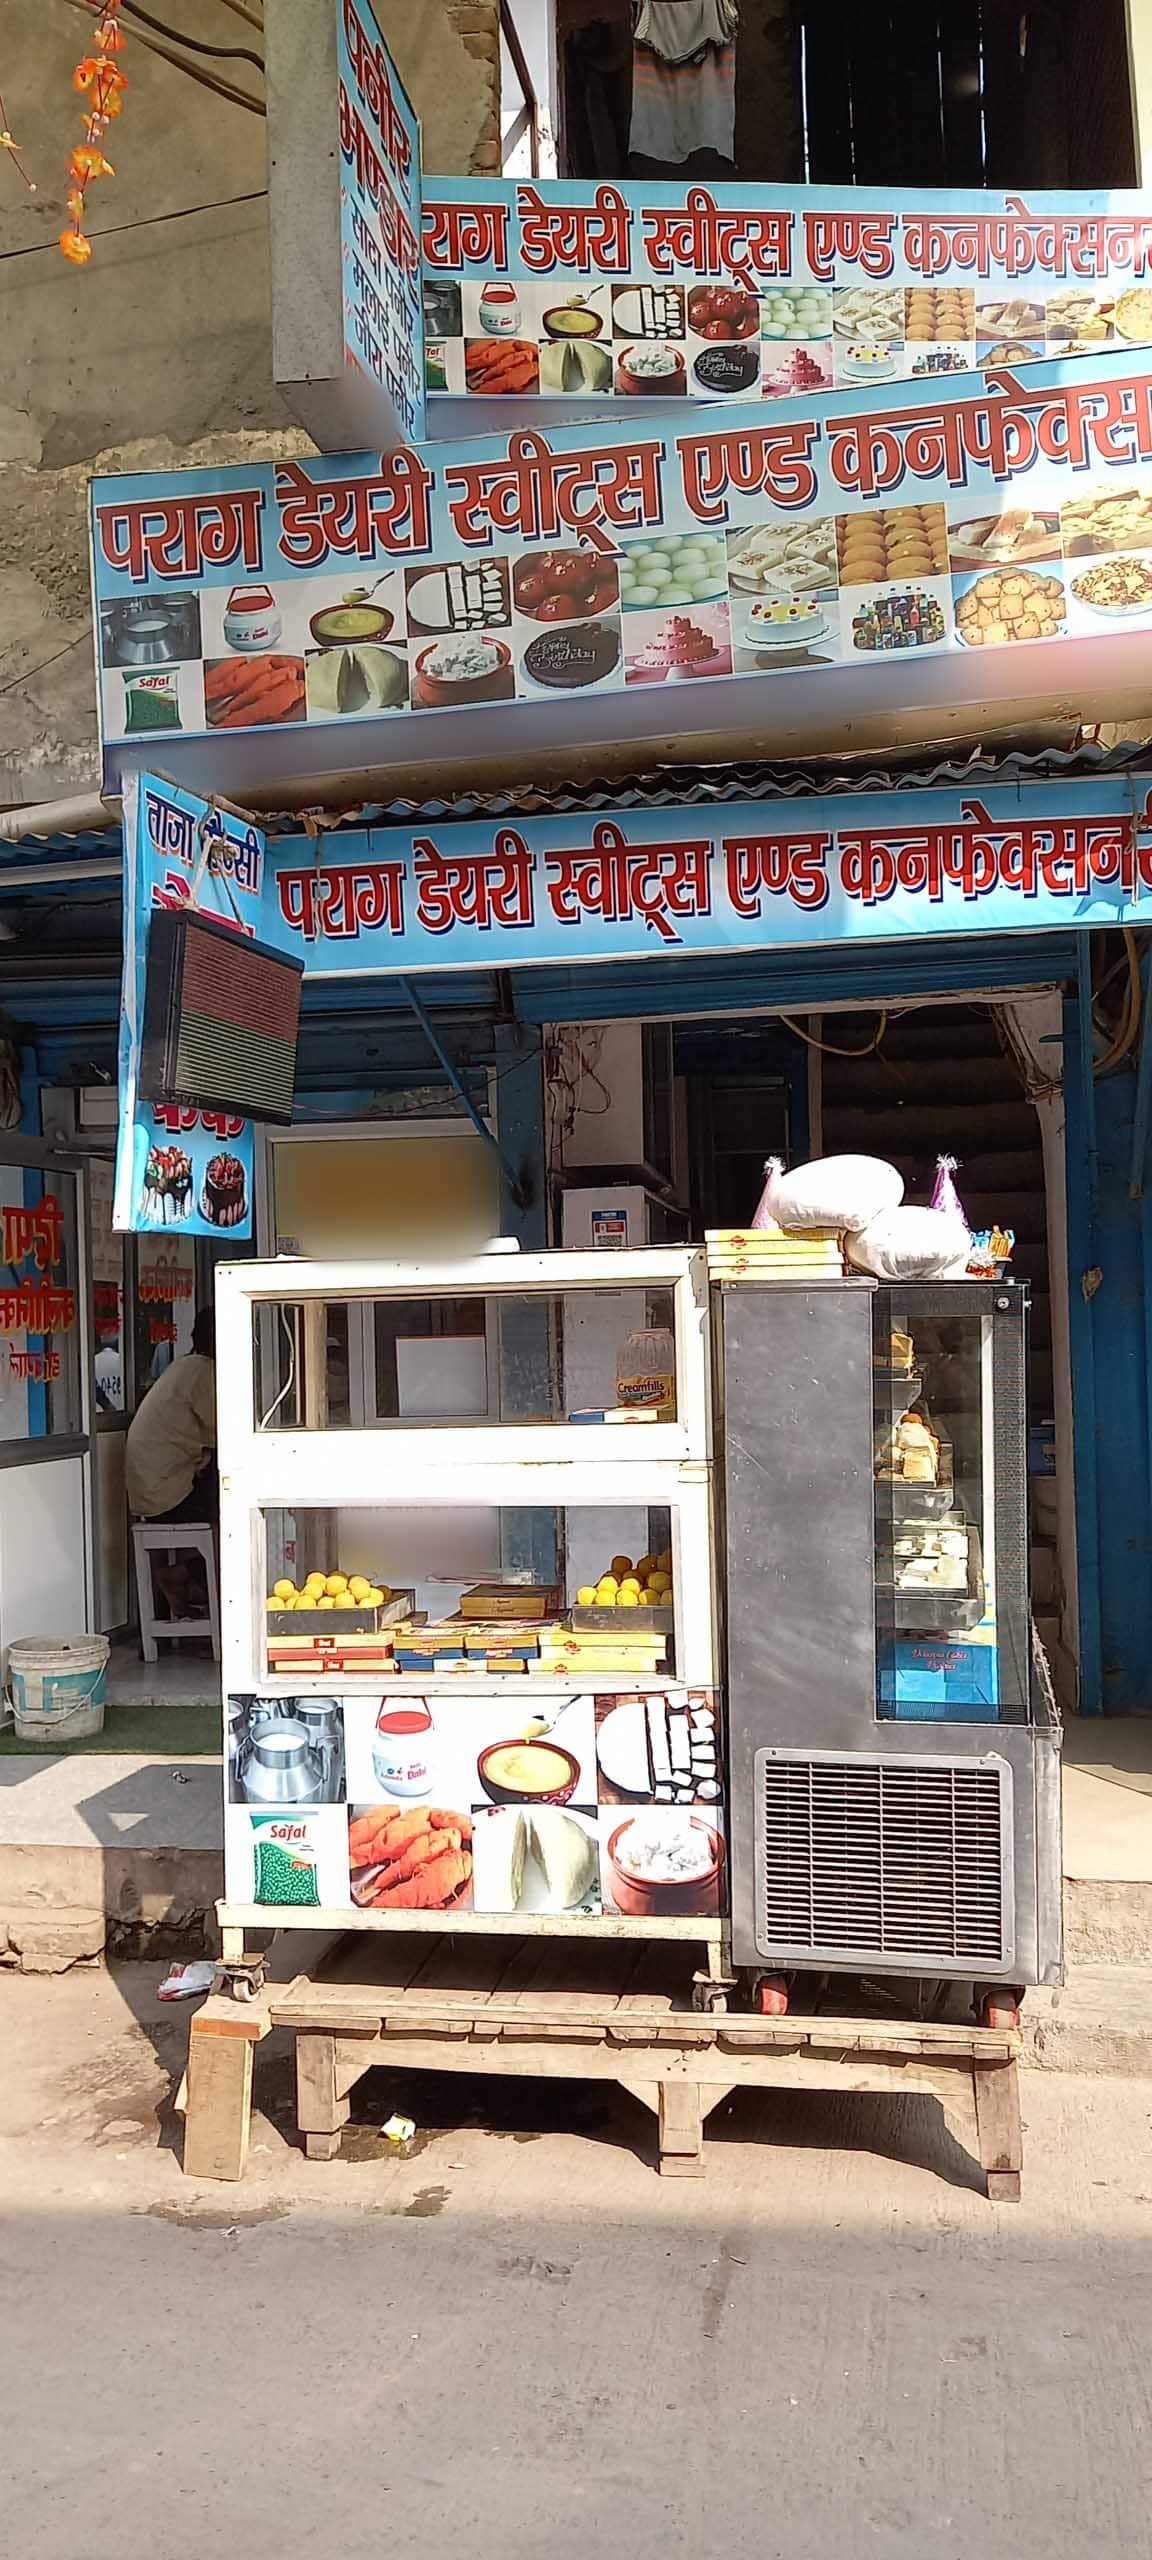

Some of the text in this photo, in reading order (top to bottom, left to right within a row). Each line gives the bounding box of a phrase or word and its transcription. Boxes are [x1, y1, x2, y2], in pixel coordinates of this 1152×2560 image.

[343, 0, 412, 194] पनीर
[340, 75, 419, 313] भण्डार
[422, 185, 1152, 296] राग डेयरी स्वीट्स एण्ड कनफेक्सन
[350, 195, 414, 347] सादा पनीर
[352, 249, 421, 405] मलाई पनीर
[354, 304, 415, 440] जीरा पनीर
[96, 489, 265, 581] पराग
[273, 446, 433, 567] डेयरी
[444, 431, 667, 557] स्वीट्स
[675, 418, 820, 523] एण्ड
[138, 676, 170, 688] Safal
[145, 789, 197, 868] ताजा
[276, 861, 406, 942] पराग
[412, 827, 536, 932] डेयरी
[545, 820, 716, 944] स्वीट्स
[722, 831, 833, 919] एण्ड
[618, 1381, 665, 1393] Creamfills
[270, 1824, 307, 1841] Safal
